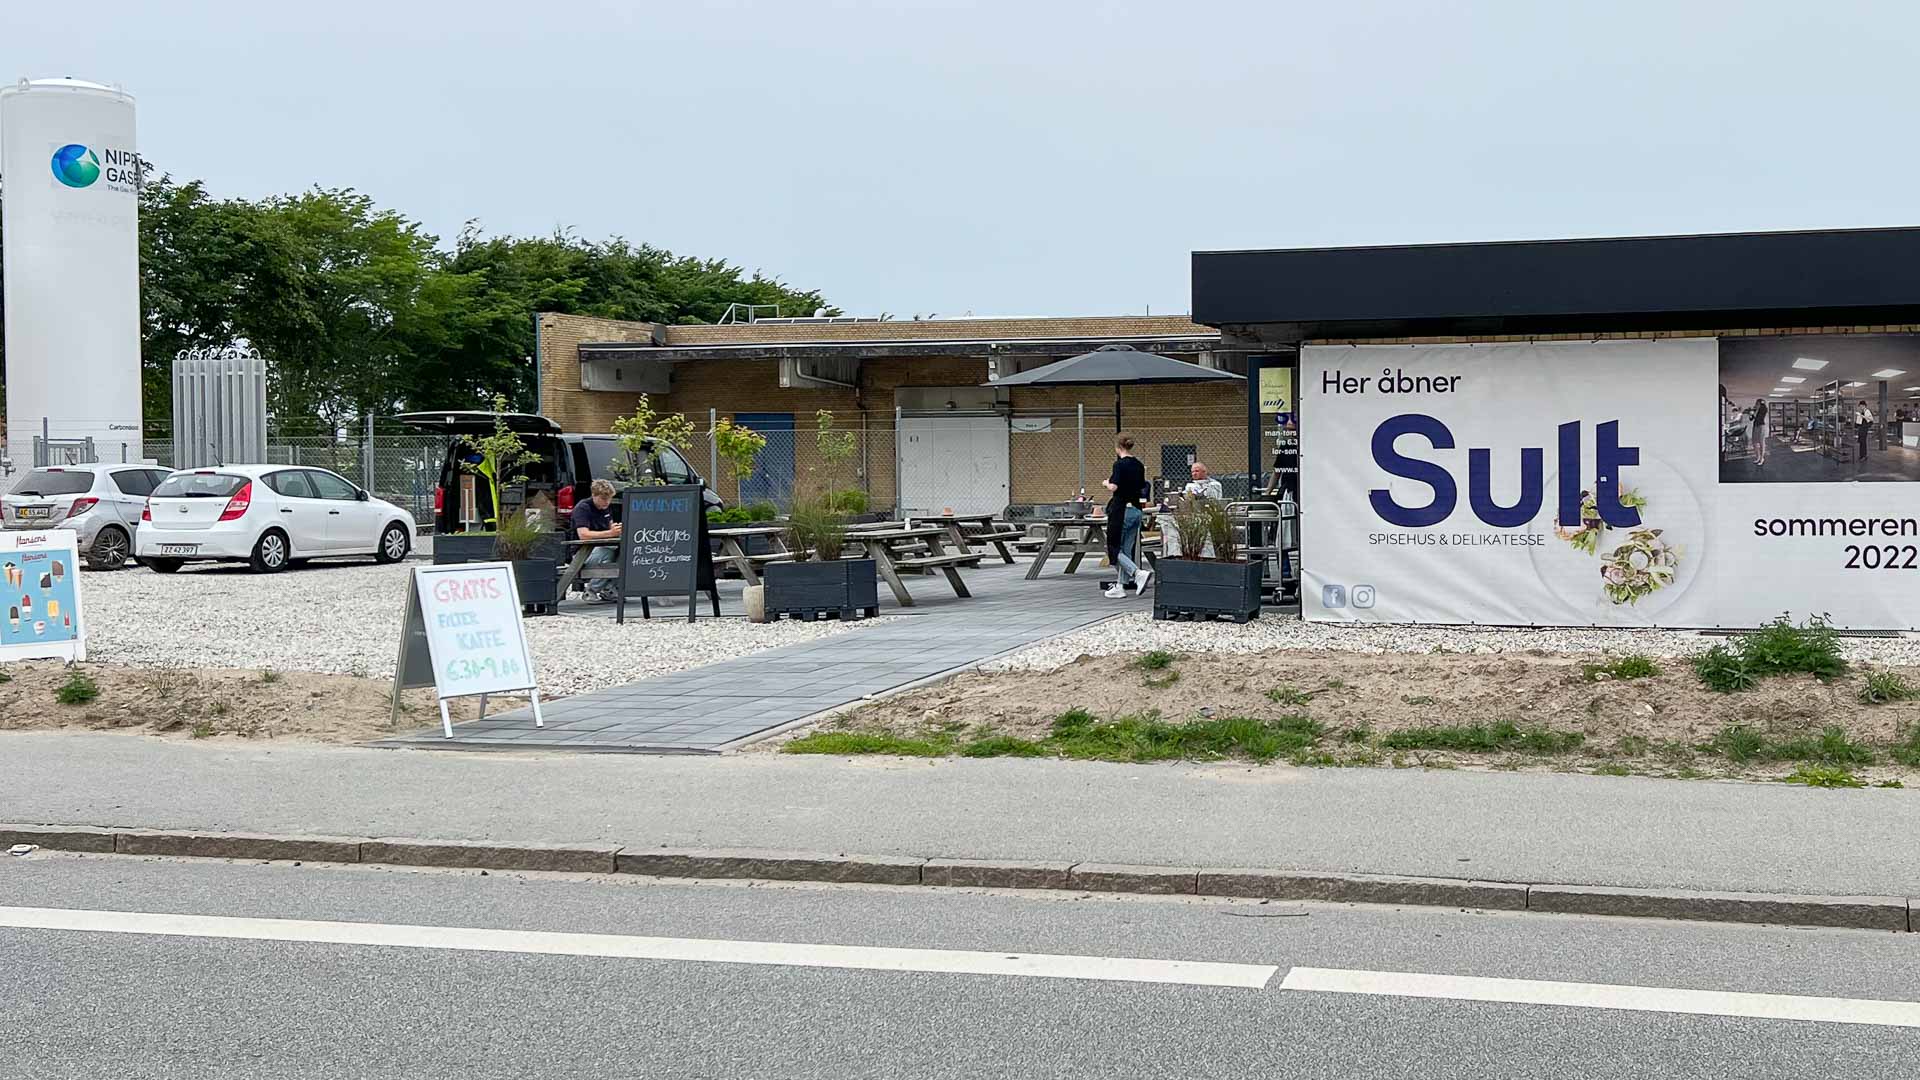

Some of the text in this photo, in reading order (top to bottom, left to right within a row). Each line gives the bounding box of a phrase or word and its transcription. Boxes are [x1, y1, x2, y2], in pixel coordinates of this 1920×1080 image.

[1322, 368, 1462, 394] Her åbner
[1368, 413, 1643, 528] Sult
[1753, 517, 1918, 537] sommeren
[1368, 533, 1545, 547] SPISEHUS & DELIKATESSE
[1844, 545, 1918, 569] 2022
[433, 577, 503, 604] GRATIS
[456, 628, 505, 650] KAFFE
